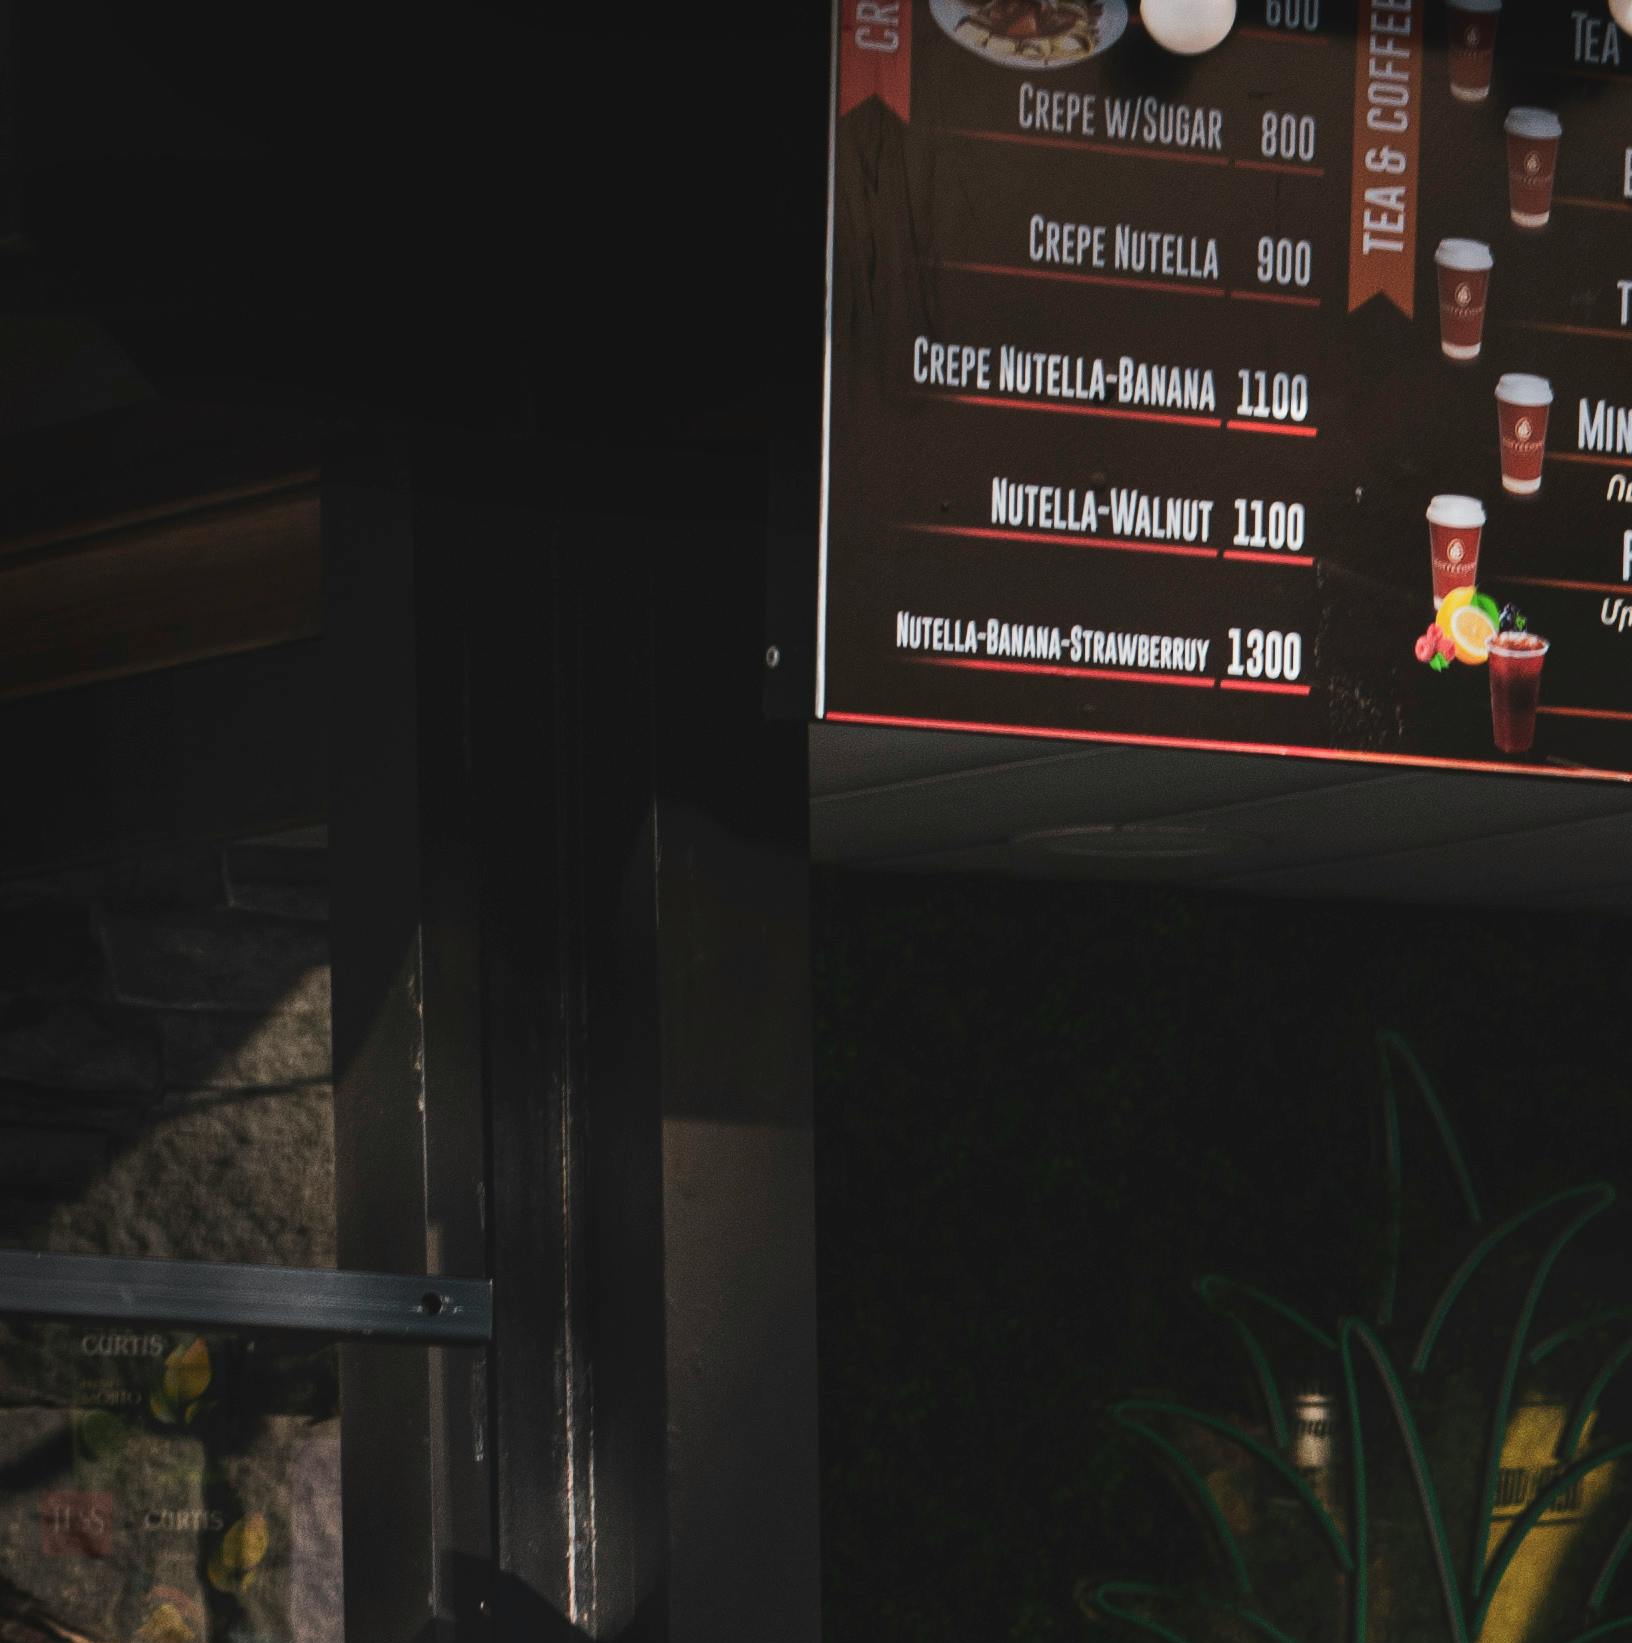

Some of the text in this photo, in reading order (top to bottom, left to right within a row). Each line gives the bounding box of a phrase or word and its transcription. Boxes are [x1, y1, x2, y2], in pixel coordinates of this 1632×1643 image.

[1570, 10, 1621, 66] TEA
[1019, 82, 1317, 161] CREPE W/SUGAR 800
[1365, 148, 1407, 173] &
[1029, 214, 1312, 286] CREPE NUTELLA 900
[1363, 185, 1408, 255] TEA
[913, 336, 1309, 421] CREPE NUTELLA-BANANA 1100
[991, 477, 1306, 551] NUTELLA-WALNUT 1100
[1227, 627, 1302, 680] 1300
